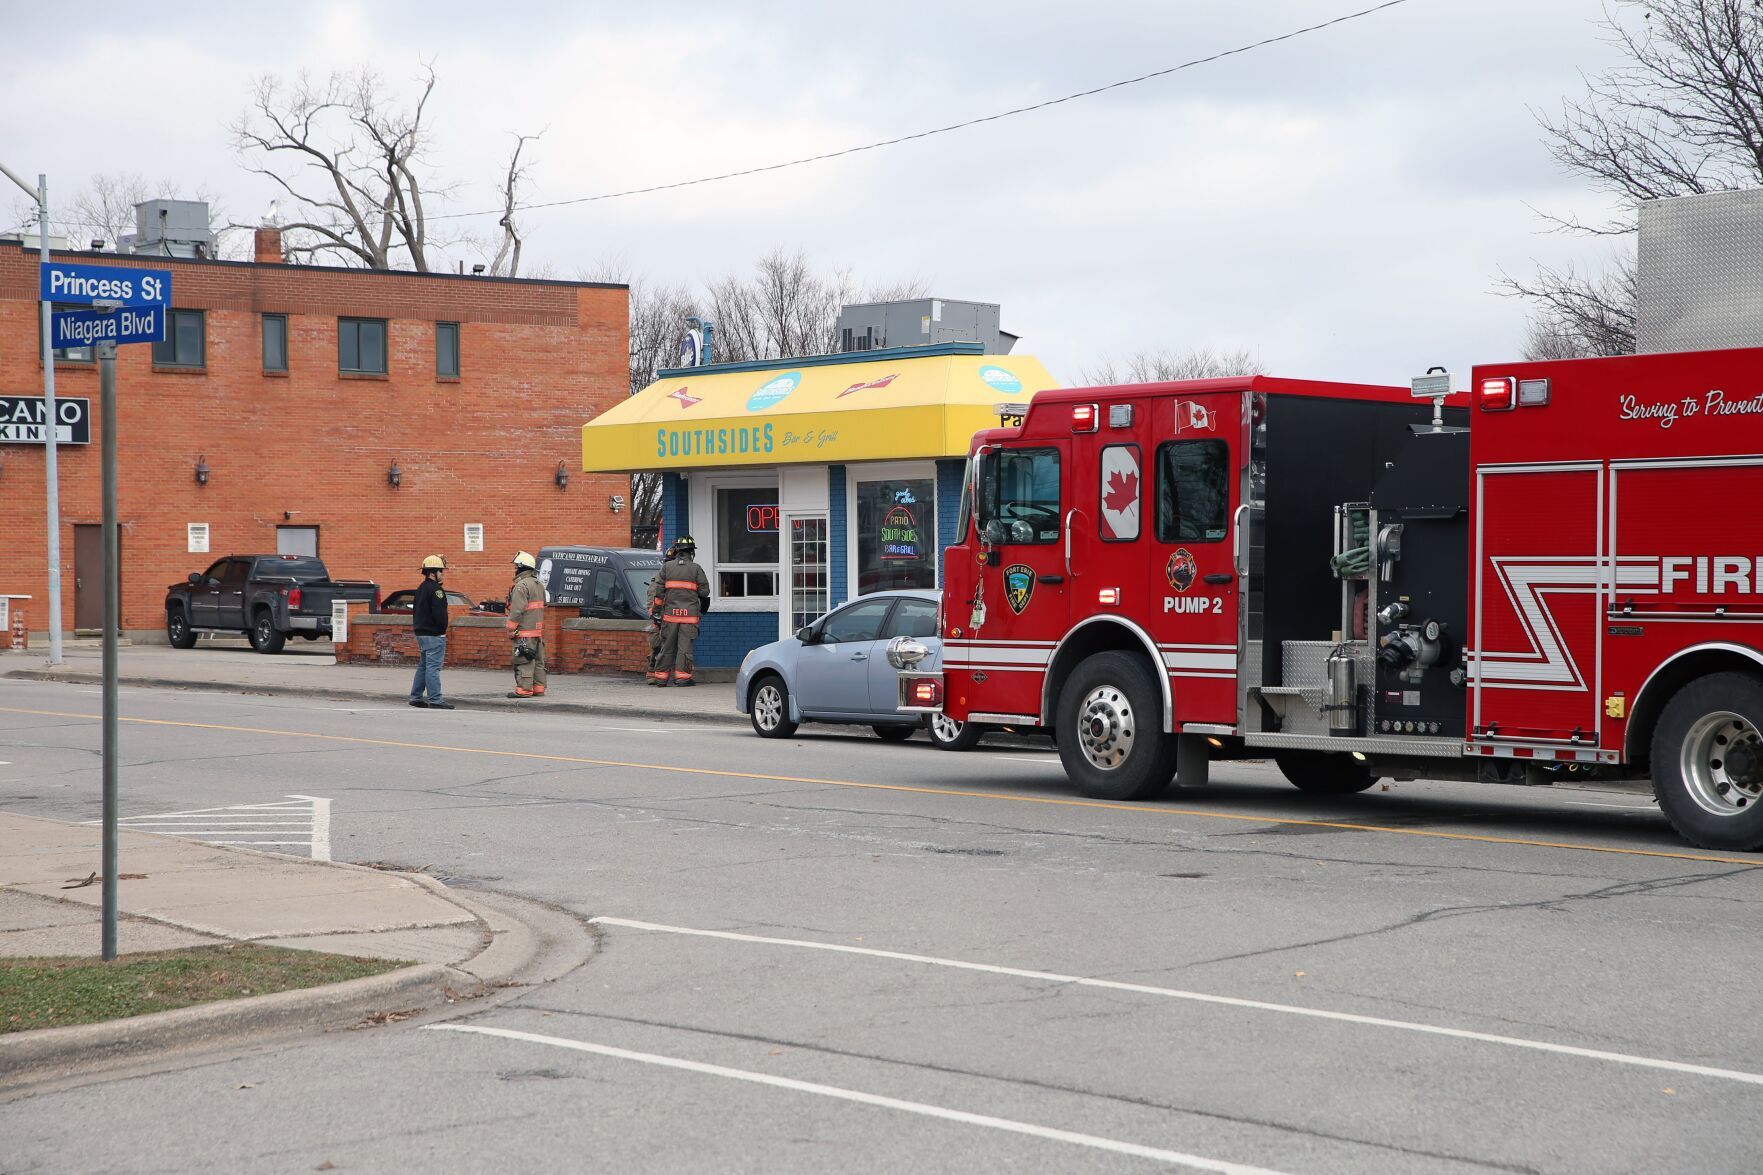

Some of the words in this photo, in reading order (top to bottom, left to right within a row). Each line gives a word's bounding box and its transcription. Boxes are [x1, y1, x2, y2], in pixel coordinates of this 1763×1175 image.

[51, 270, 133, 299] Princess
[141, 276, 163, 300] St
[60, 317, 117, 344] Niagara
[121, 310, 155, 336] Blvd
[1681, 397, 1700, 417] to
[0, 425, 58, 439] KIN
[657, 422, 774, 458] SOUTHSIDES
[890, 516, 909, 525] PATIO
[575, 553, 609, 565] RESTAURANT
[1006, 566, 1020, 576] FORT
[1020, 566, 1033, 576] ERIE
[1661, 556, 1763, 594] FIR
[672, 608, 688, 616] FEFD
[1164, 596, 1210, 614] PUMP
[1212, 597, 1223, 614] 2
